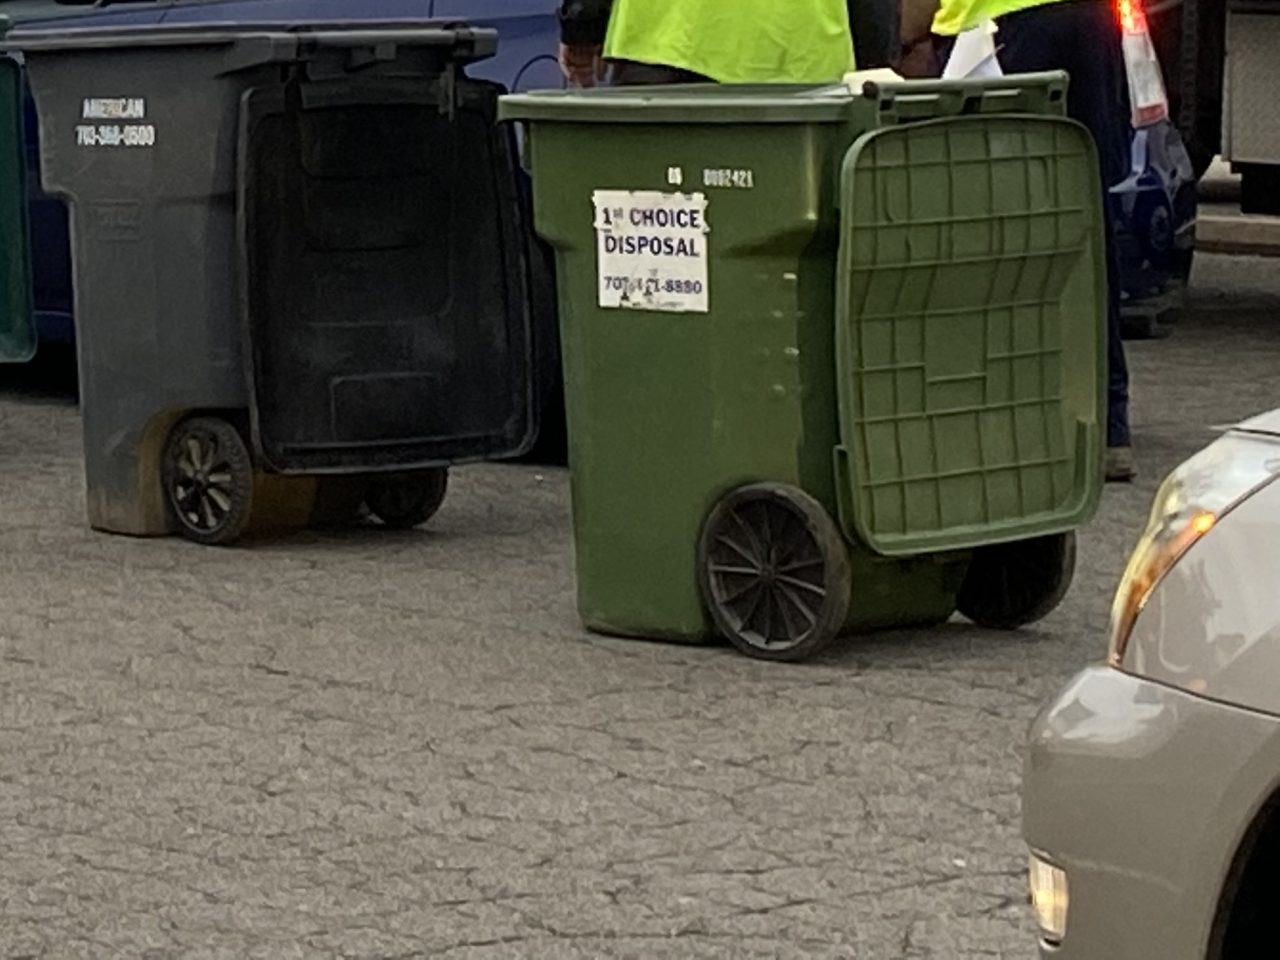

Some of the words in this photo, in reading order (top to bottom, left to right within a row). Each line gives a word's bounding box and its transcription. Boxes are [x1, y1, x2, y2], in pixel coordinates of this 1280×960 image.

[83, 98, 145, 119] AMERICAN
[629, 208, 701, 229] CHOICE
[604, 236, 700, 257] DISPOSAL
